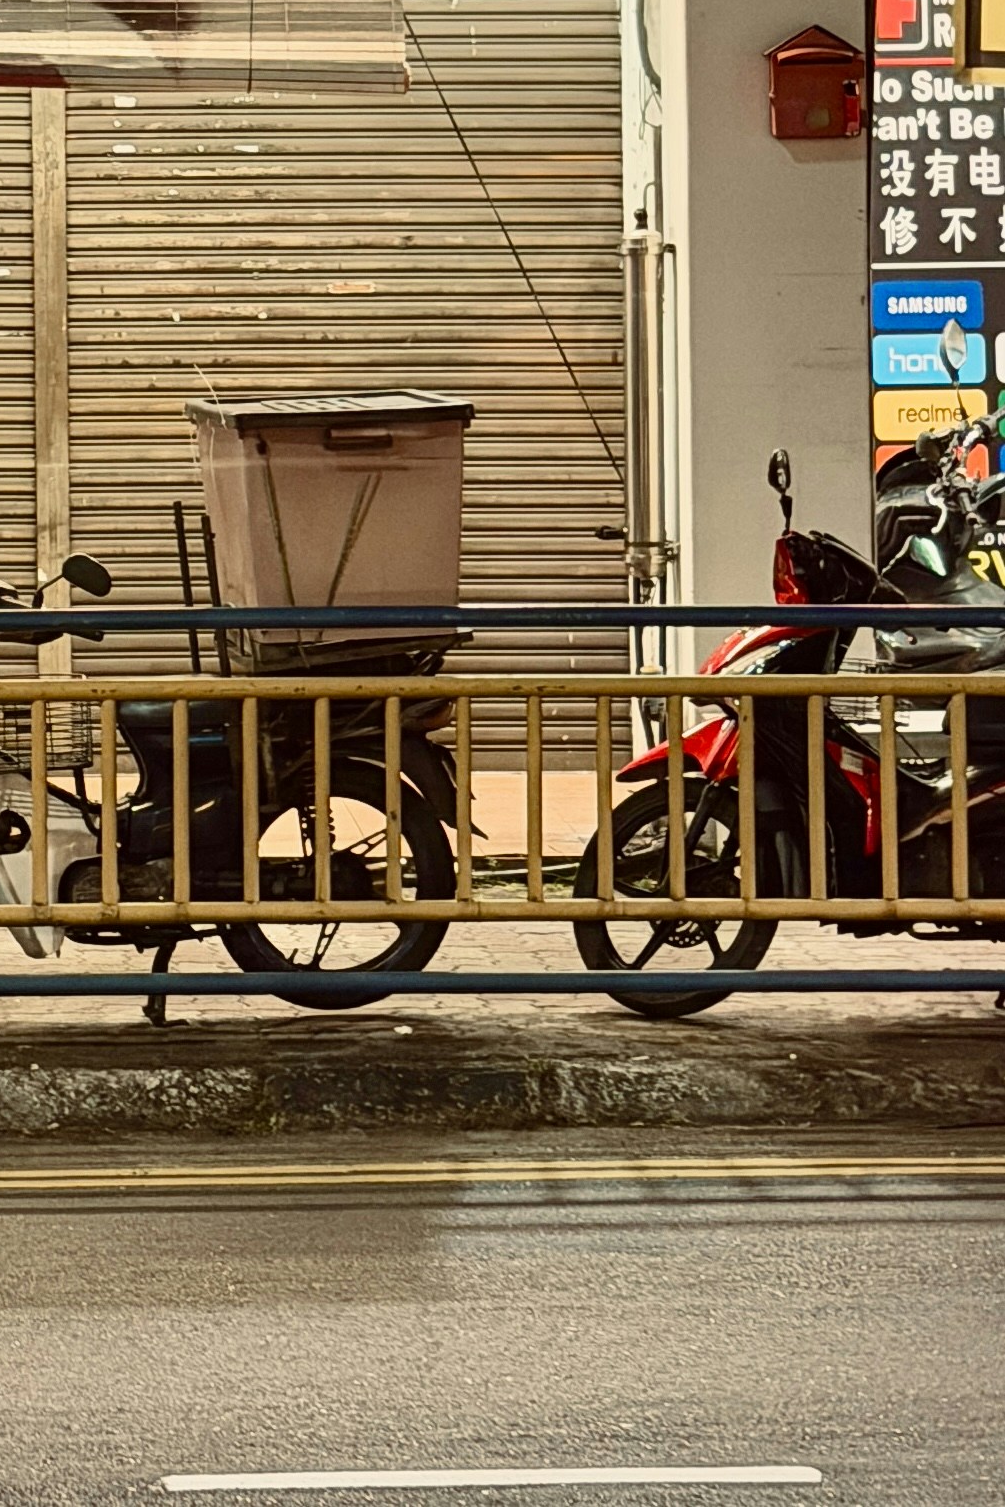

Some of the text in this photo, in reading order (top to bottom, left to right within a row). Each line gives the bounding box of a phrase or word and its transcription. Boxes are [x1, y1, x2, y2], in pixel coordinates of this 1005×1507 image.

[872, 107, 995, 141] an't Be
[887, 296, 968, 314] SAMSUNG
